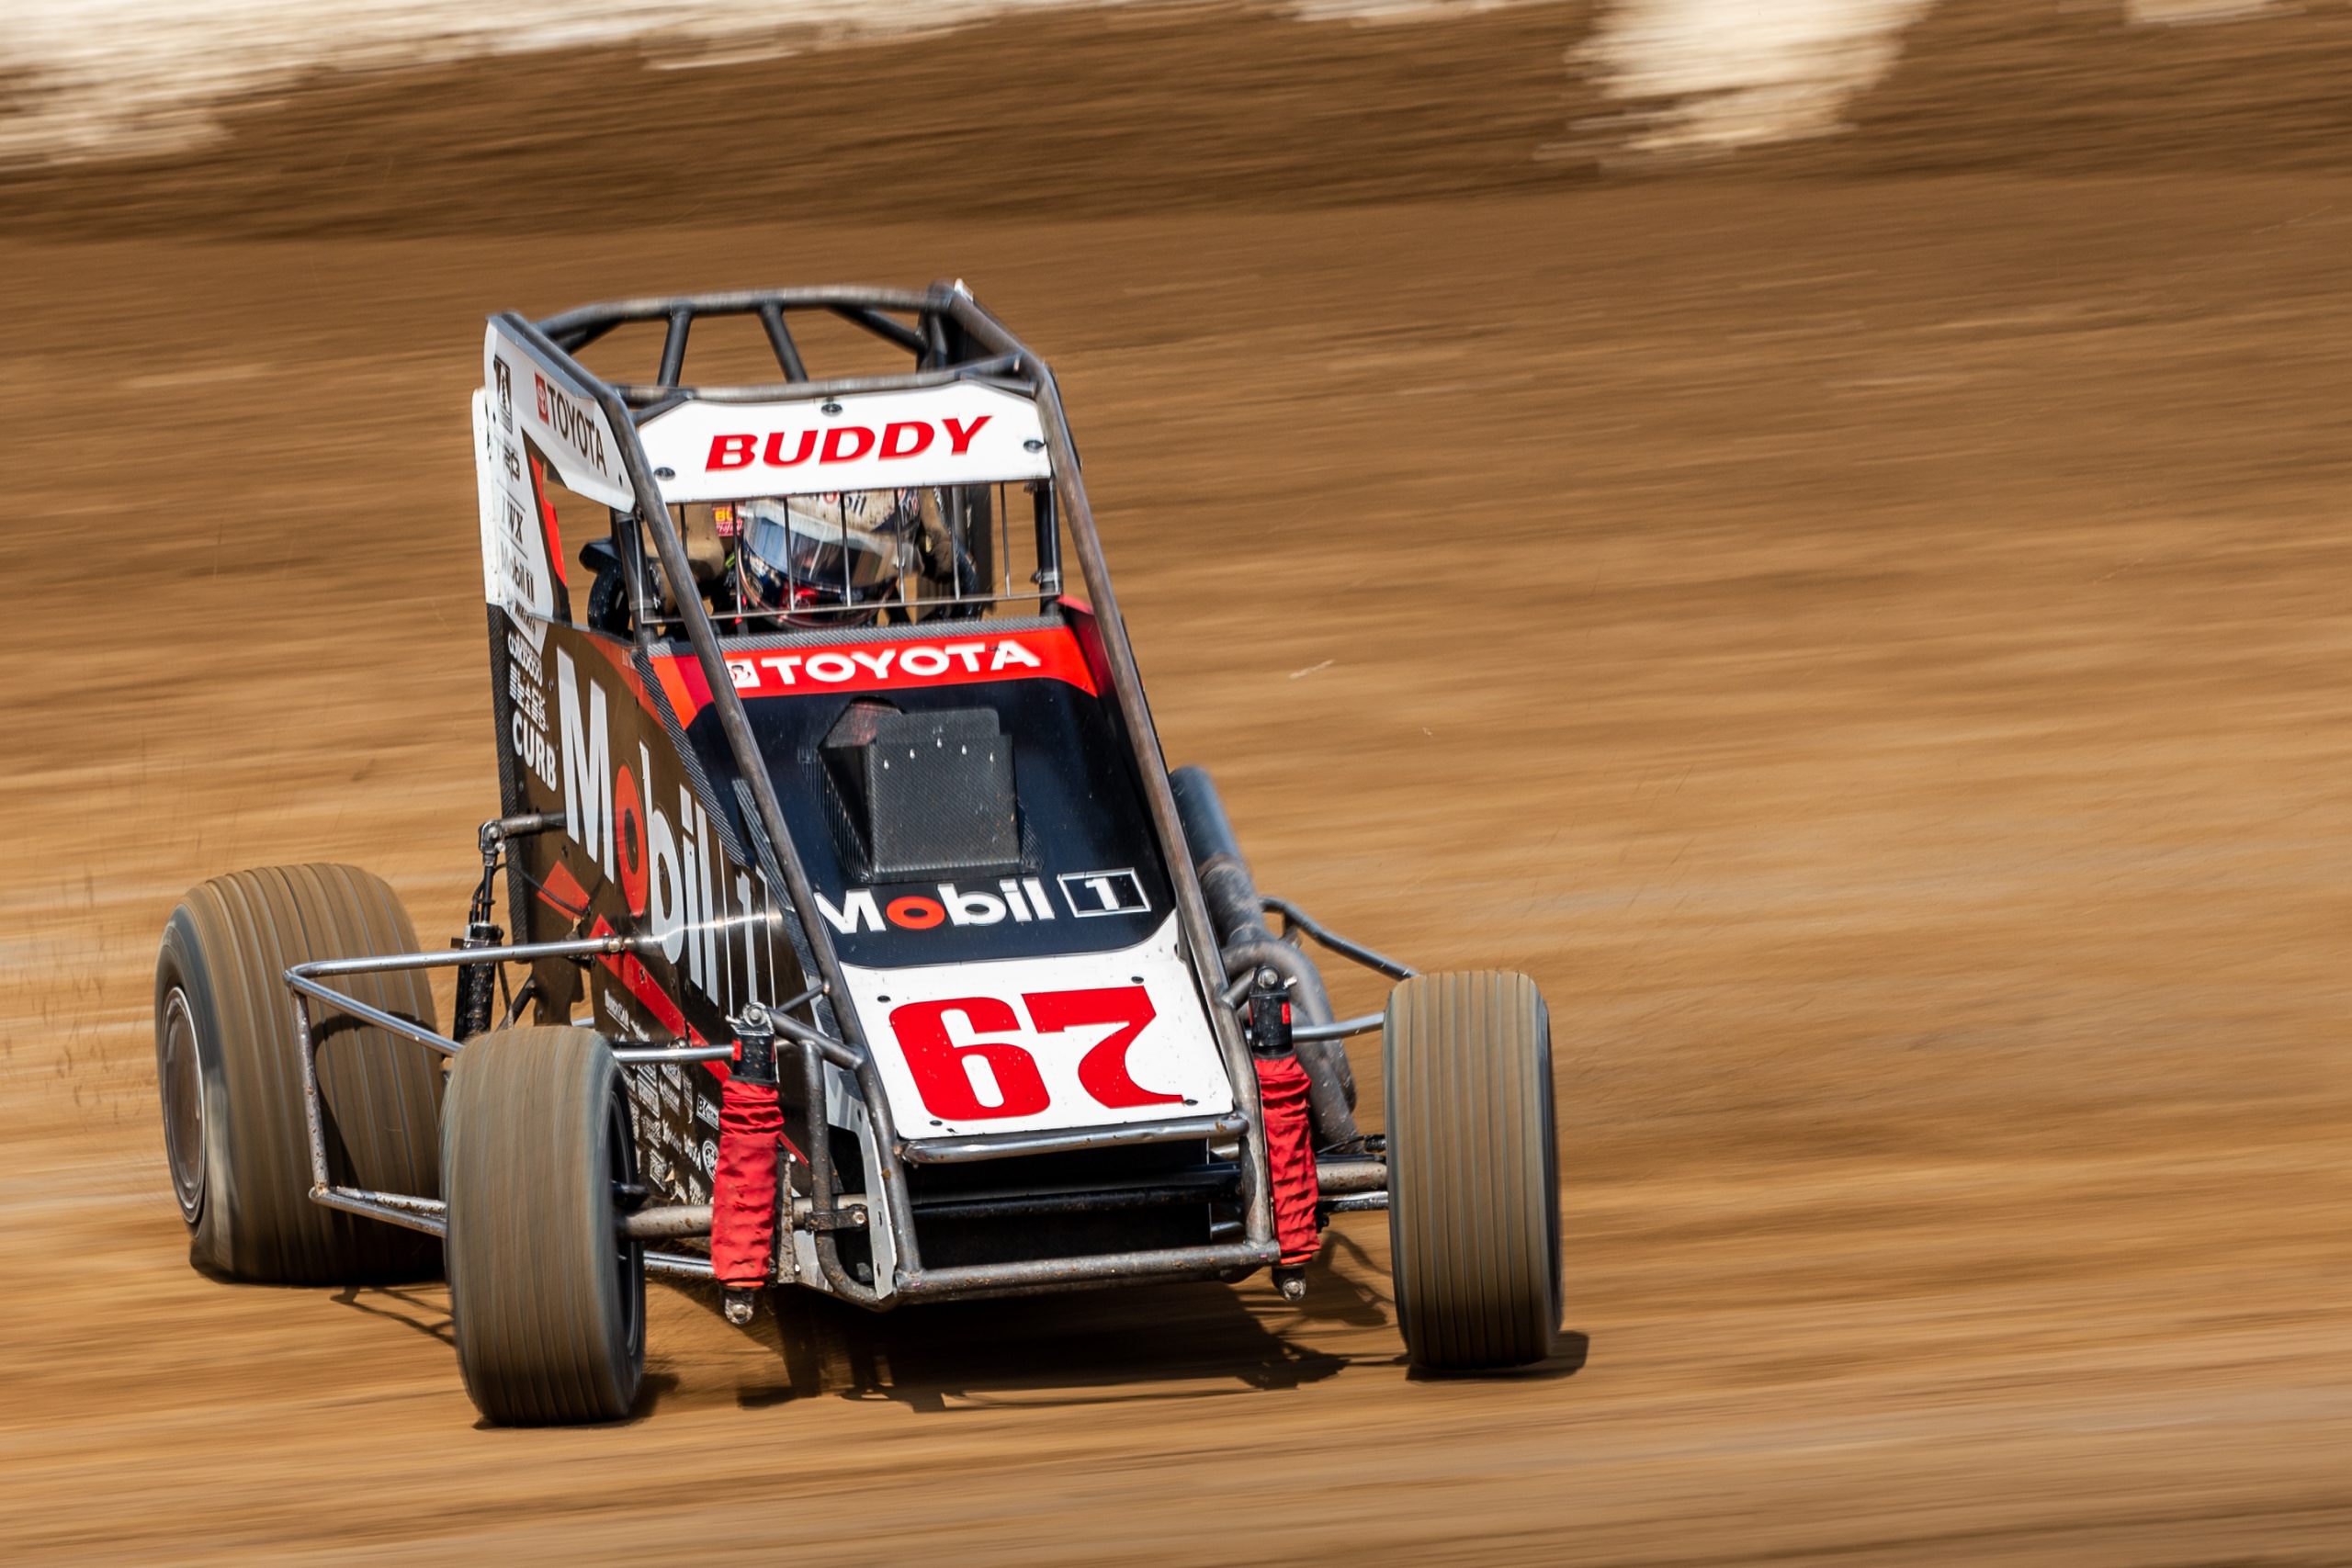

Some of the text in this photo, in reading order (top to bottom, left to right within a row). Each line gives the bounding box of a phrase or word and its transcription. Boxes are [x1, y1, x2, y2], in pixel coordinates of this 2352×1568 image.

[547, 384, 609, 478] TOYOTA
[706, 415, 992, 473] BUDDY
[500, 540, 526, 597] Mobil
[761, 639, 1041, 685] TOYOTA
[513, 707, 557, 792] CURB
[556, 645, 719, 1009] Mobil
[814, 875, 1121, 935] Mobil 1
[888, 985, 1184, 1122] 67
